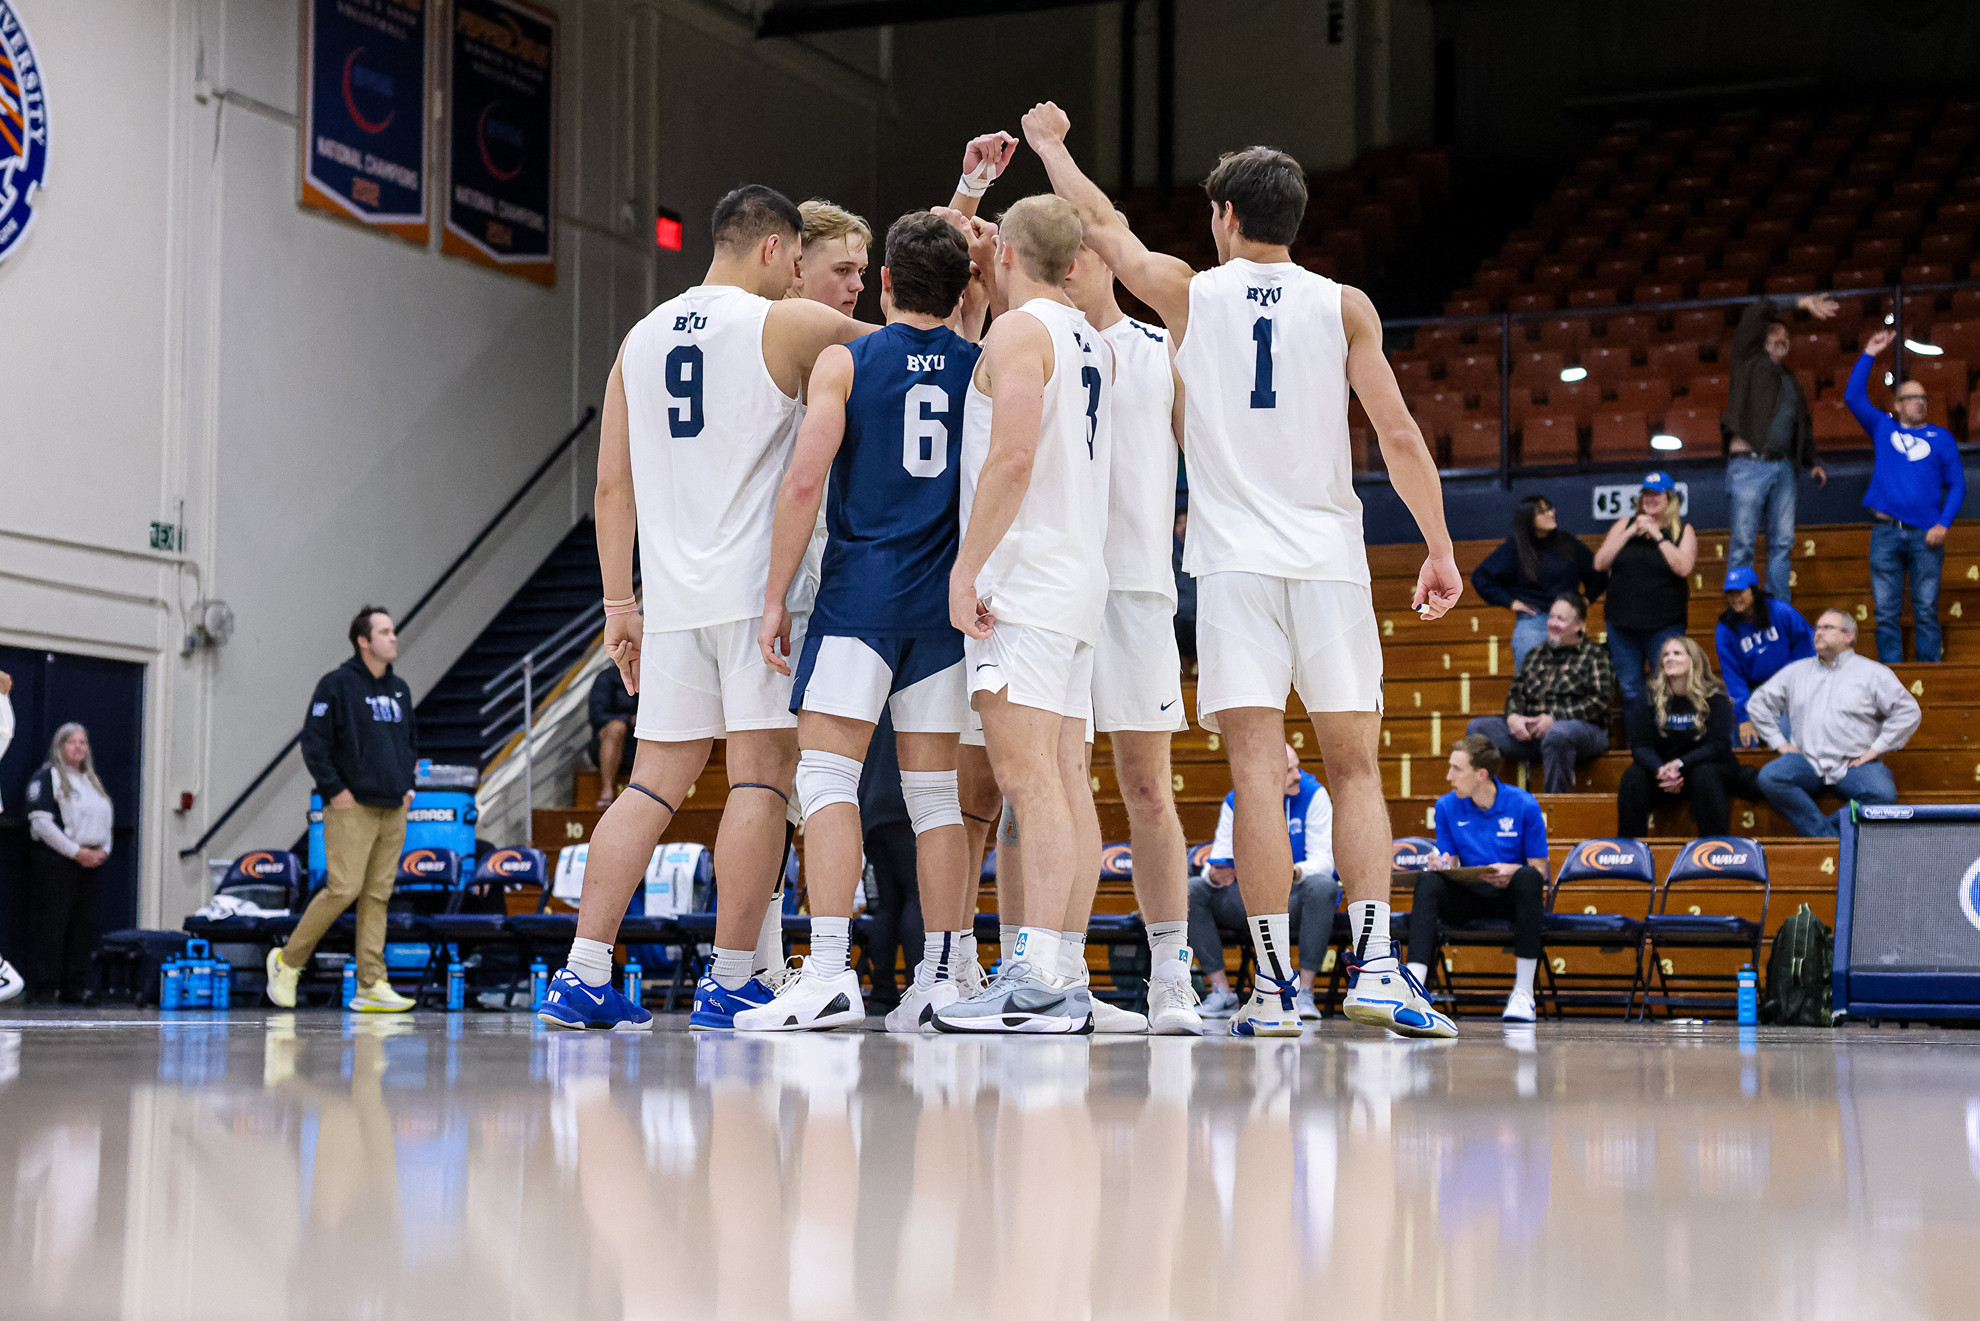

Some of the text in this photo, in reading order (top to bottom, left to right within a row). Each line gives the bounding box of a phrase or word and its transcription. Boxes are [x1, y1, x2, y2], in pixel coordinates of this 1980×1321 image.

[0, 4, 47, 147] VERSITY
[1246, 285, 1282, 307] BYU
[906, 354, 946, 372] BYU
[1250, 316, 1276, 409] 1
[665, 344, 704, 438] 9
[1081, 366, 1102, 461] 3
[902, 383, 949, 478] 6
[1610, 491, 1621, 514] 5
[1804, 539, 1816, 557] 2
[1967, 565, 1980, 581] 4
[1856, 604, 1868, 621] 3
[1950, 601, 1963, 618] 4
[1383, 620, 1394, 636] 2
[1741, 626, 1779, 653] BYU
[1207, 734, 1220, 751] 3
[1292, 732, 1304, 749] 2
[1742, 811, 1755, 829] 3
[566, 822, 584, 839] 10
[1598, 853, 1635, 865] WAVES
[1711, 853, 1748, 865] WAVES
[1820, 857, 1836, 875] 4
[1552, 957, 1566, 974] 2
[1661, 958, 1674, 975] 3
